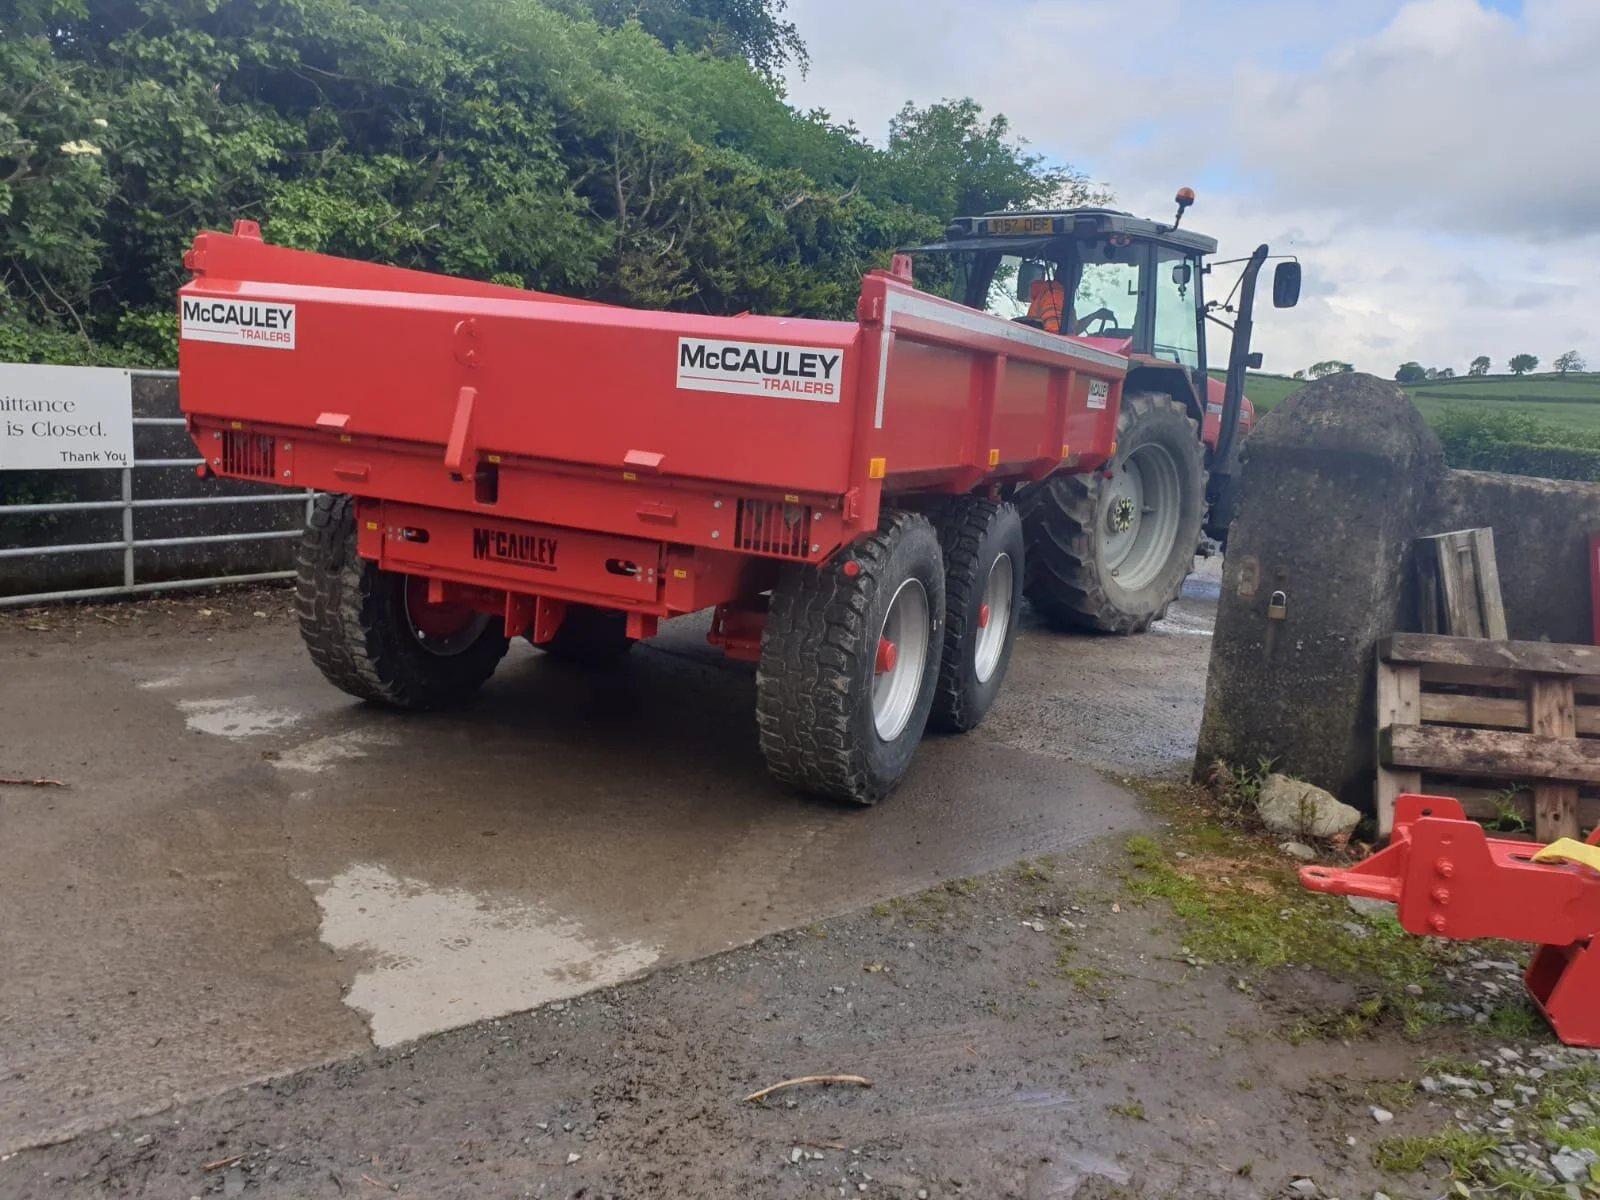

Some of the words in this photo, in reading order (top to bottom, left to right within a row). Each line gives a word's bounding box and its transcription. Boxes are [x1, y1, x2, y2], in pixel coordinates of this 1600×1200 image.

[183, 301, 293, 329] McCAULEY
[241, 329, 291, 343] TRAILERS
[680, 344, 839, 379] McCAULEY
[762, 378, 834, 395] TRAILERS
[0, 396, 76, 412] ittance
[7, 421, 24, 436] is
[32, 421, 107, 437] Closed.
[60, 451, 100, 462] Thank
[104, 450, 126, 462] You
